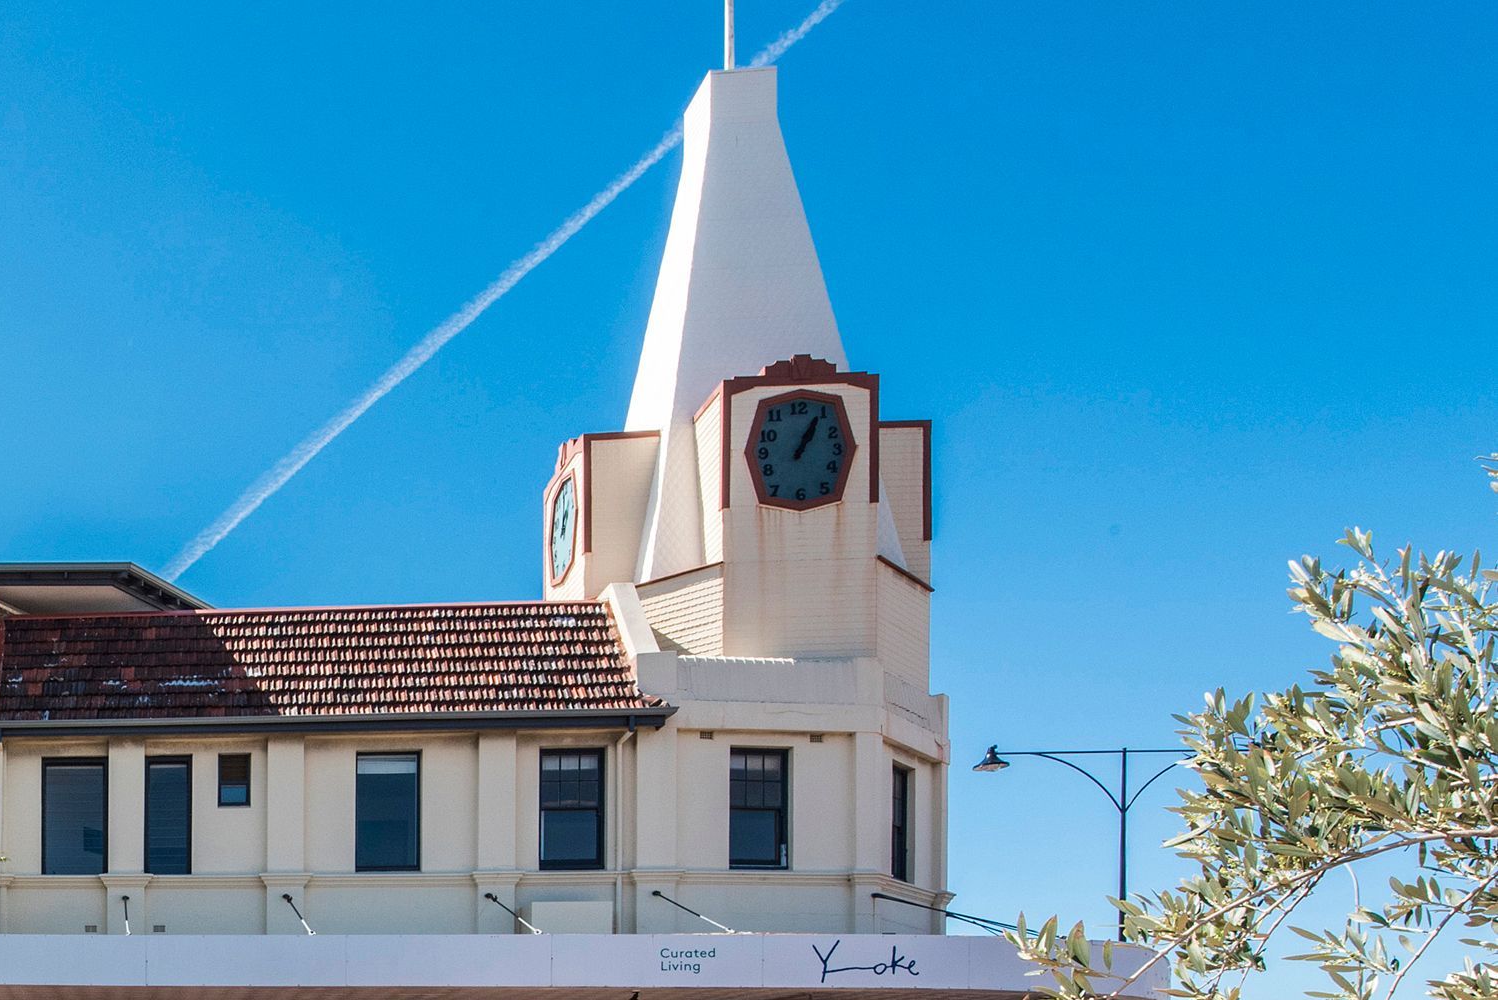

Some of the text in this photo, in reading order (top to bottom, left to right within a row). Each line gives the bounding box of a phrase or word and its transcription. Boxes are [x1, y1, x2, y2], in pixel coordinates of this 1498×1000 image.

[790, 402, 808, 415] 12
[820, 406, 827, 419] 1
[768, 409, 782, 422] 11
[760, 429, 777, 443] 10
[828, 426, 838, 439] 2
[758, 447, 769, 460] 9
[832, 443, 842, 456] 3
[763, 464, 774, 476] 8
[826, 461, 838, 473] 4
[769, 485, 779, 497] 7
[795, 488, 806, 501] 6
[820, 482, 830, 495] 5
[660, 948, 716, 959] Curated
[660, 961, 701, 974] Living
[812, 940, 919, 983] Yoke
